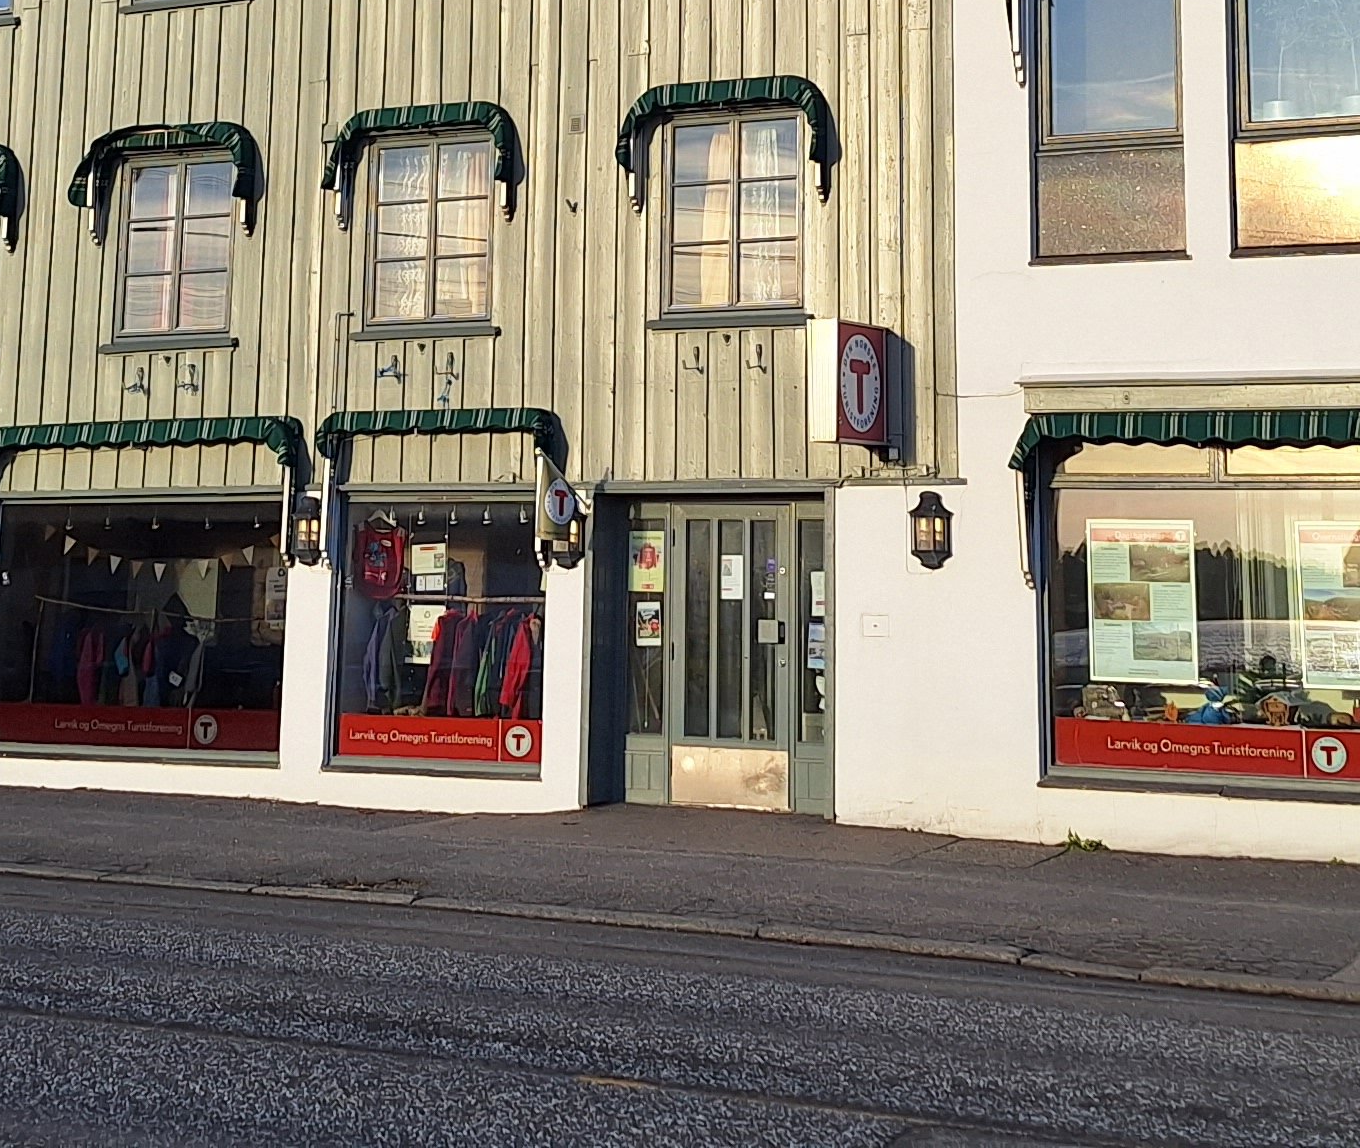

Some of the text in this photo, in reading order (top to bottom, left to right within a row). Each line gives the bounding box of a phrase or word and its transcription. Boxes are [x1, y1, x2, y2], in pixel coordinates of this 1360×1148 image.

[854, 339, 877, 370] NORSKE
[849, 358, 871, 415] T
[842, 383, 879, 429] TURISTFORENING
[349, 728, 493, 747] Larvik og Omegns Turistforening
[1107, 736, 1141, 751] Larvik
[1143, 741, 1158, 754] og
[1160, 739, 1211, 756] Omegns
[1212, 741, 1295, 761] Turistforening
